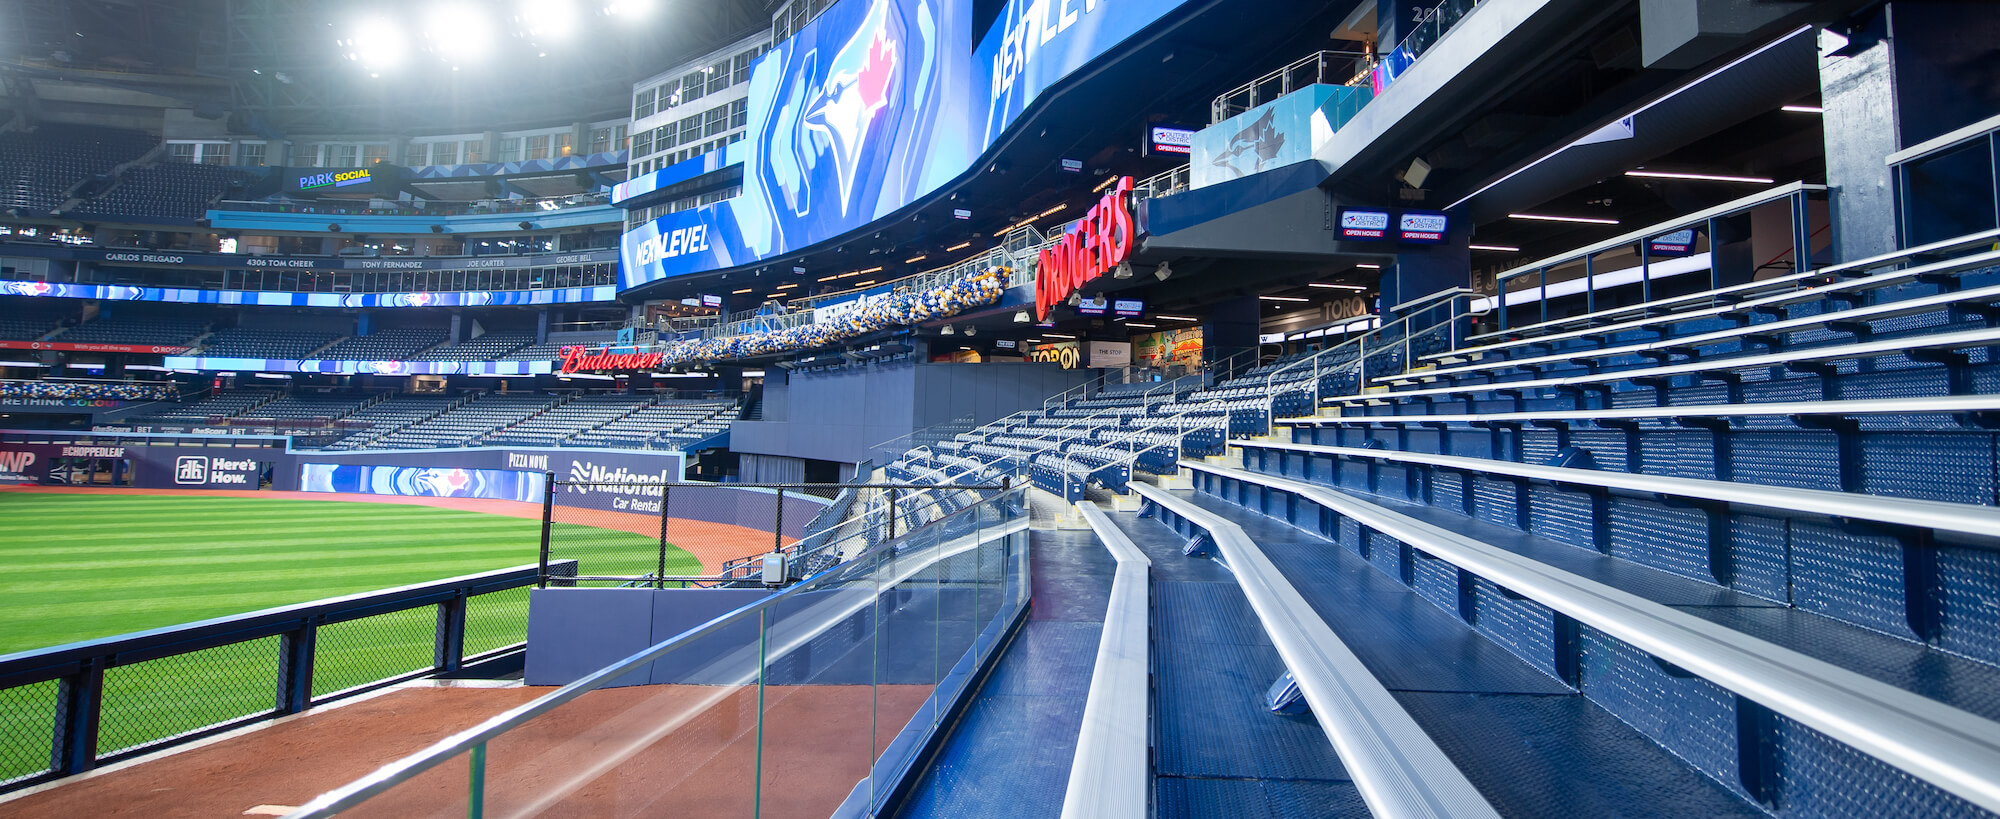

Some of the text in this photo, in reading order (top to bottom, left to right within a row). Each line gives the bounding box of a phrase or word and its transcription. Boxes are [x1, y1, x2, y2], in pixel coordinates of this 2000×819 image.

[300, 169, 370, 187] PARK SOCIAL
[635, 224, 709, 268] NEXT LEVEL
[1050, 176, 1133, 305] ROGERS
[105, 253, 184, 264] CARLOS DELGADO
[247, 259, 314, 268] 4306 TOM CHEEK
[383, 261, 422, 269] FERNANDEZ
[467, 259, 505, 268] JOE CARTER
[556, 254, 592, 264] GEORGE BELL
[557, 345, 663, 374] Budweiser
[68, 446, 124, 458] CHOPPEDLEAF
[212, 458, 256, 471] Here's
[509, 453, 547, 470] PIZZA NOVA
[211, 472, 247, 484] How.
[590, 465, 668, 497] National
[613, 497, 662, 512] Car Rental
